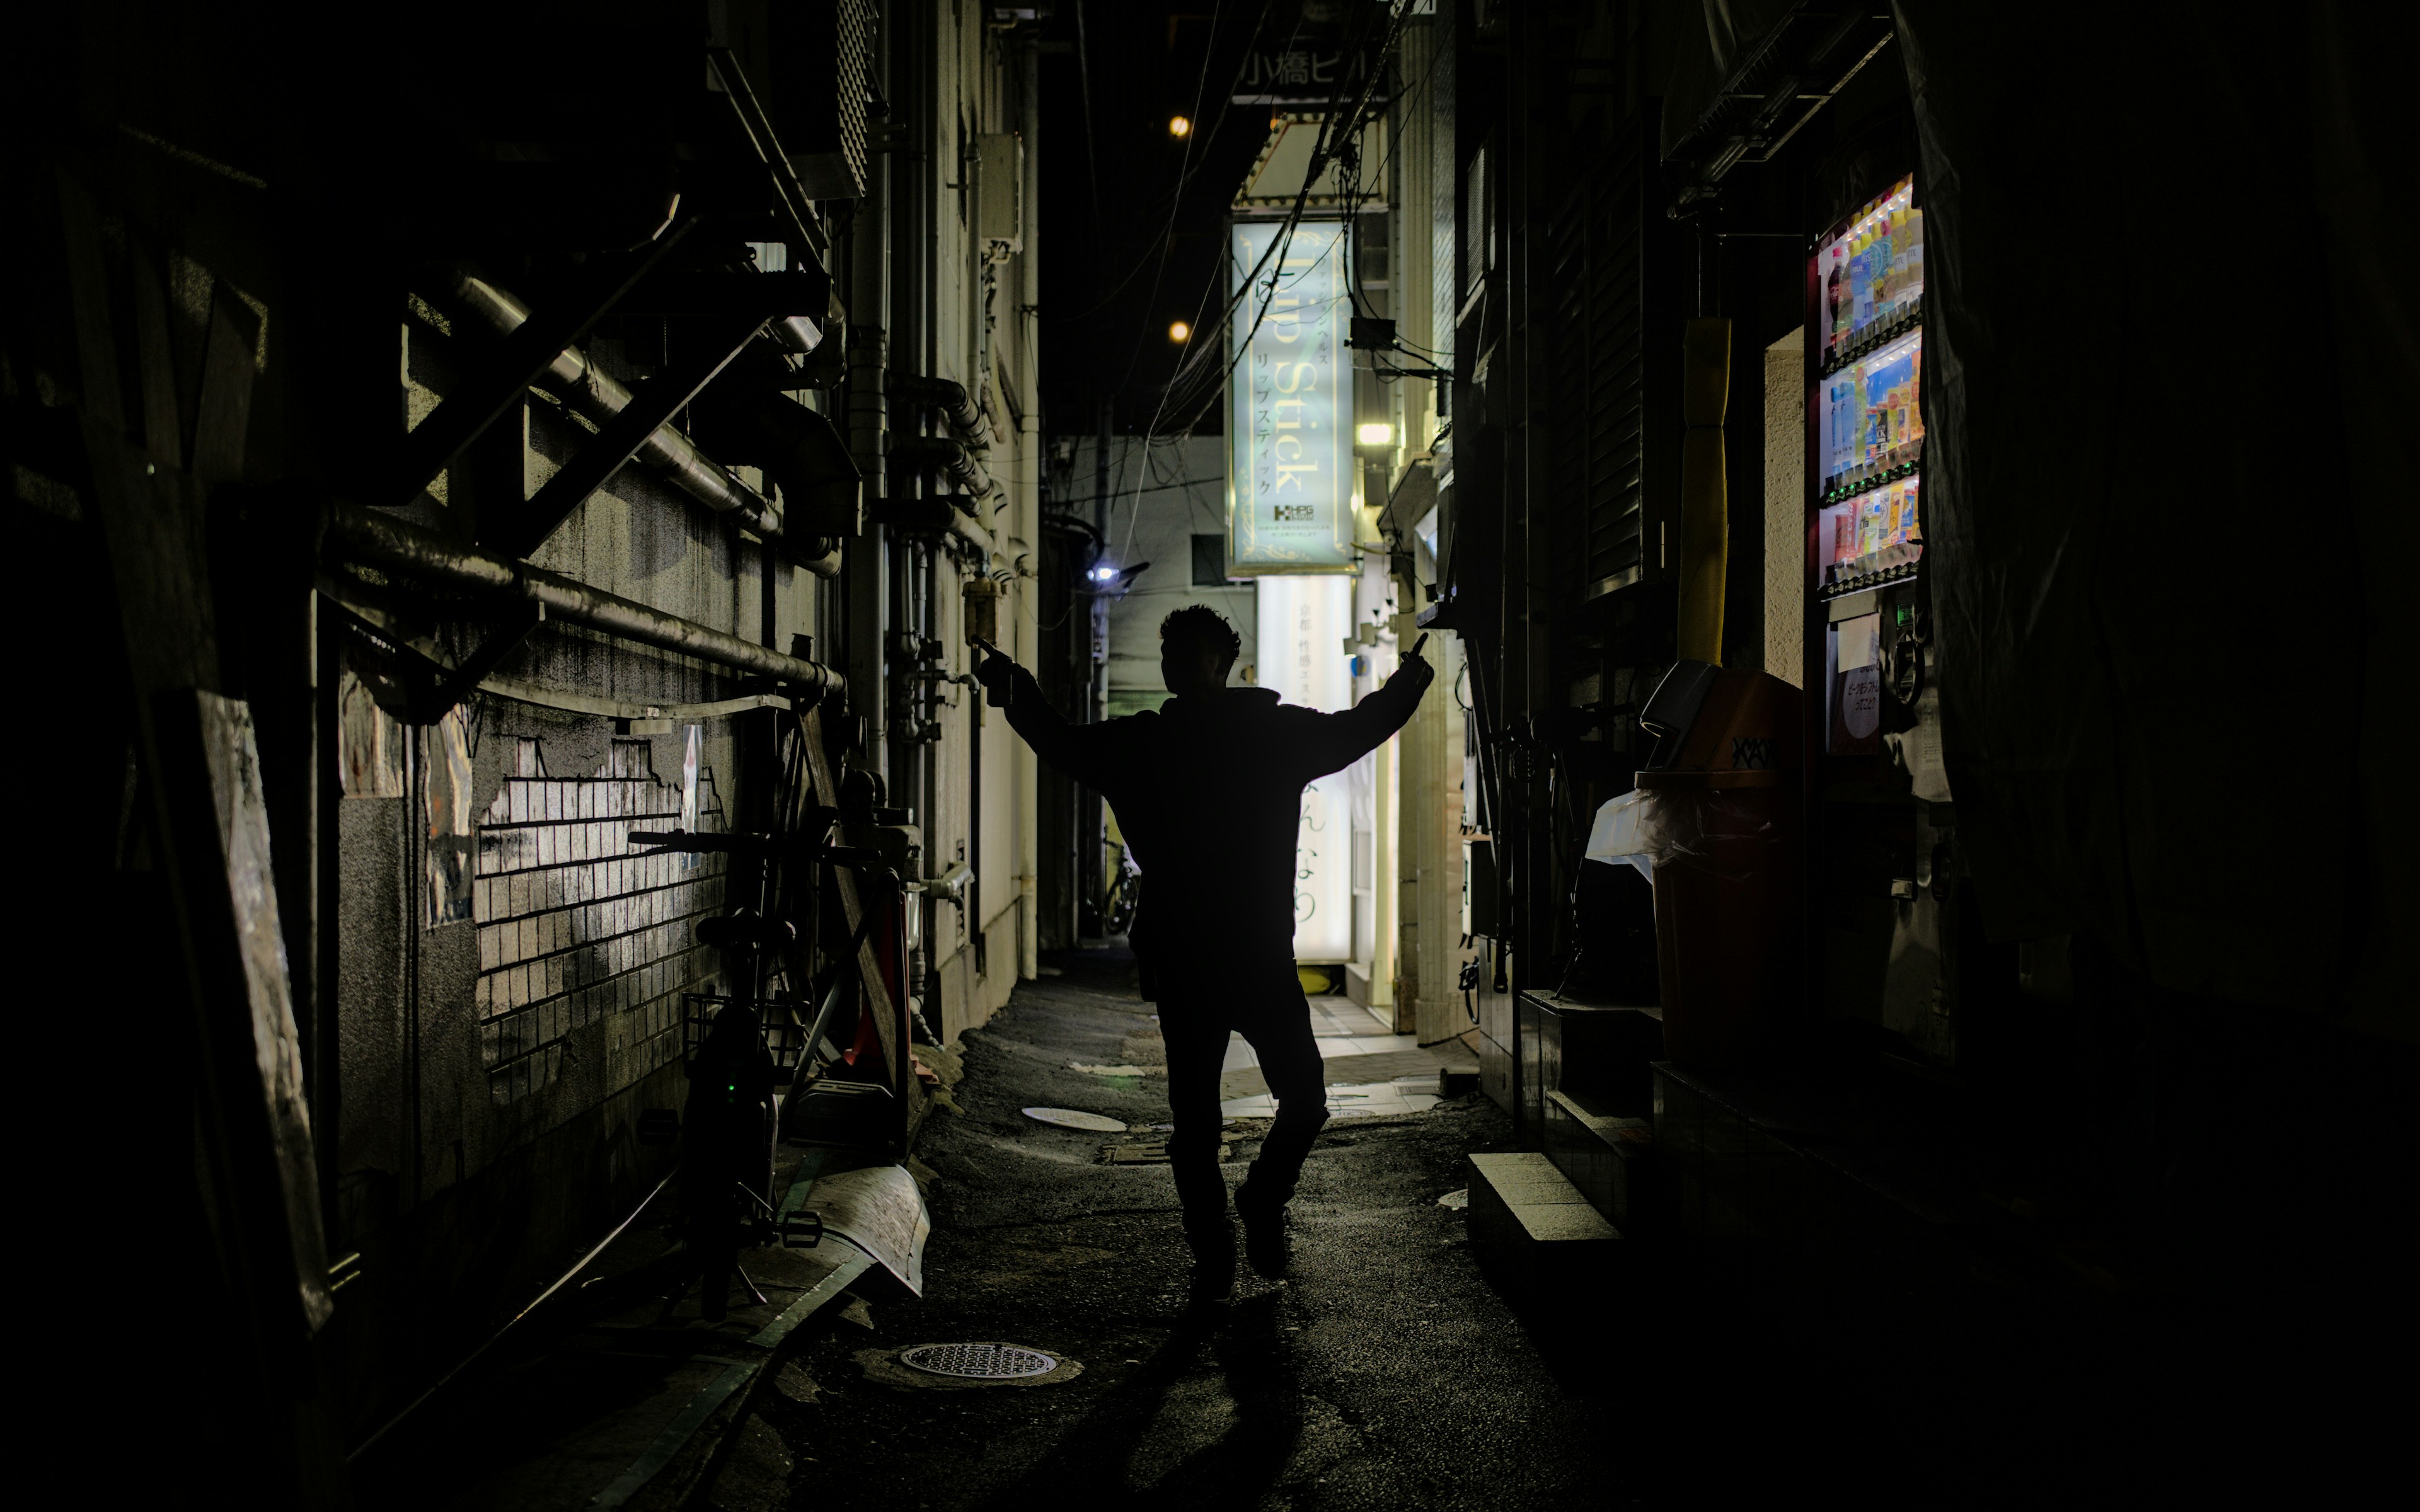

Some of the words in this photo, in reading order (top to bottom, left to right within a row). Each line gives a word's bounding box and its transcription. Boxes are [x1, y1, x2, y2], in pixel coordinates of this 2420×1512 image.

[1239, 50, 1366, 86] 小橋ビ
[1256, 353, 1272, 496] リップスティック
[1274, 361, 1319, 495] Stick
[1291, 505, 1315, 514] HPG
[1299, 604, 1312, 632] 京都
[1293, 784, 1326, 923] んなり
